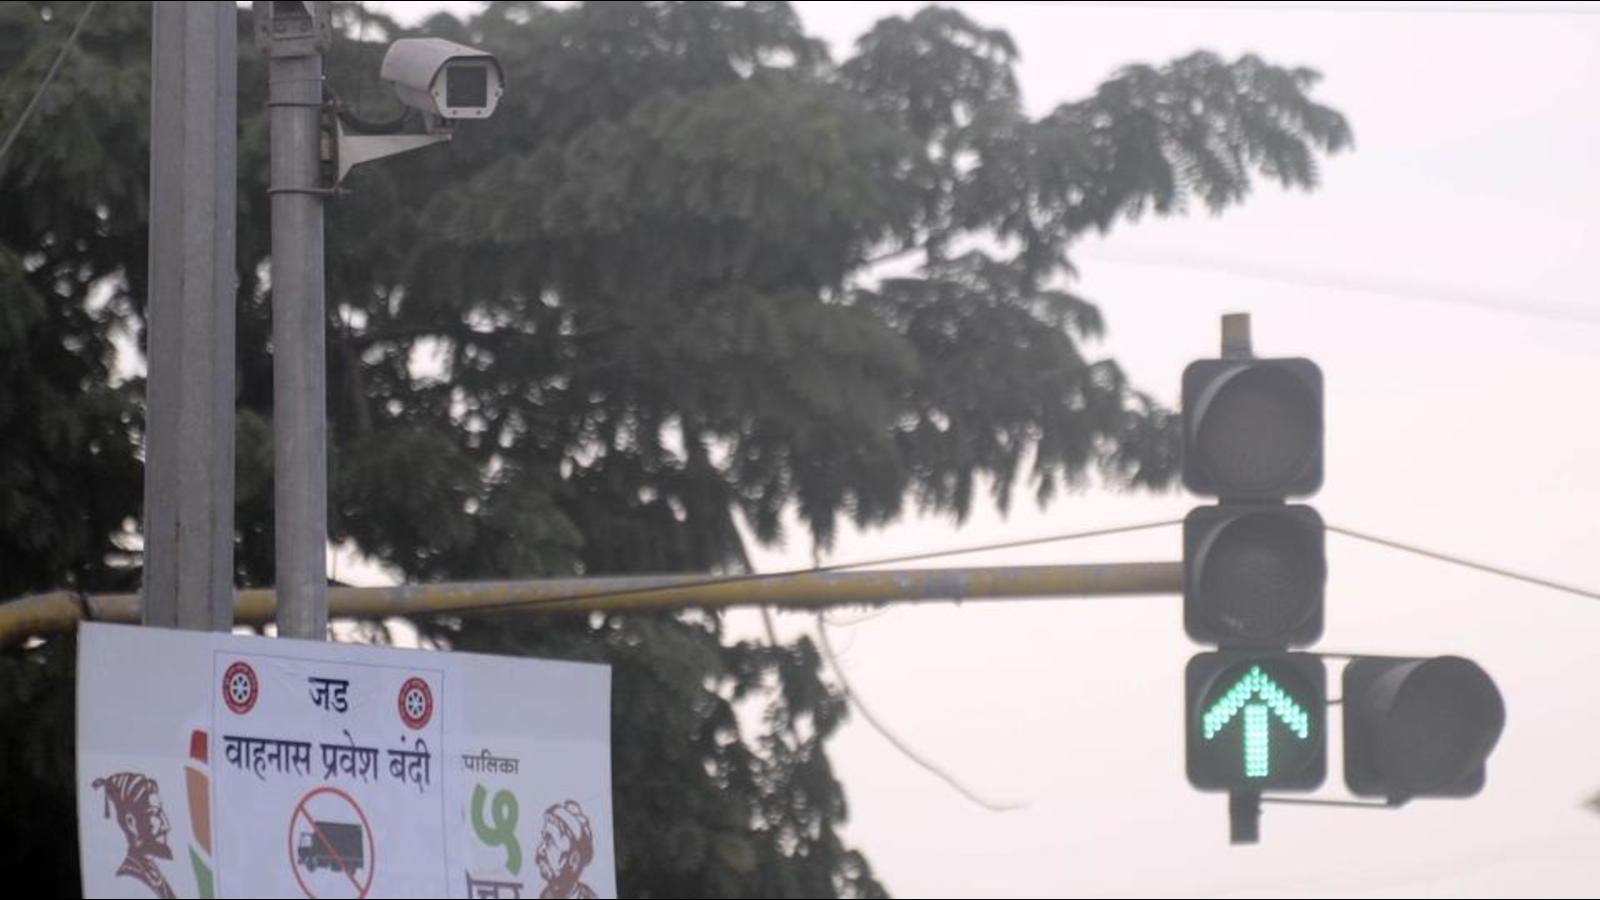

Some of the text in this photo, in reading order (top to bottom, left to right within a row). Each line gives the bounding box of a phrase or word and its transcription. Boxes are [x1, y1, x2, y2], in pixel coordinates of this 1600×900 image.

[308, 676, 350, 713] जड
[223, 729, 431, 793] वाहनास प्रवेश बंदी
[461, 749, 520, 774] पालिका
